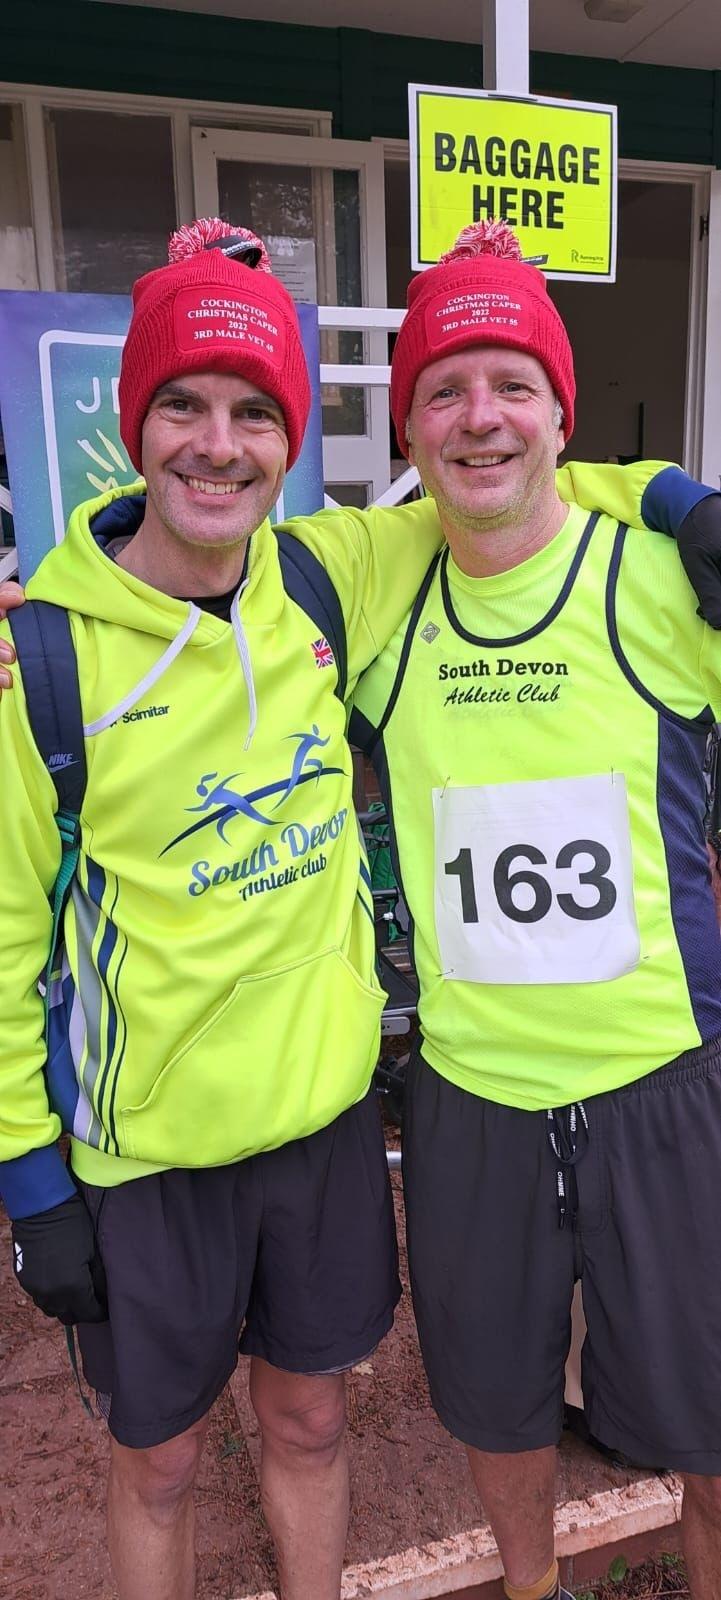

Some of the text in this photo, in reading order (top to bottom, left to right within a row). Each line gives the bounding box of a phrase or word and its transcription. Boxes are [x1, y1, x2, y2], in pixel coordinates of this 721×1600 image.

[434, 132, 600, 185] BAGGAGE
[472, 184, 565, 229] HERE
[201, 299, 268, 320] COCKINGTON
[436, 300, 522, 317] CHRISTMAS CAPER
[447, 293, 509, 306] COCKINGTON
[187, 309, 278, 336] CHRISTMAS CAPER
[471, 308, 490, 316] 2022
[228, 320, 248, 331] 2022
[441, 321, 459, 333] 3RD
[460, 316, 488, 326] MALE
[489, 316, 507, 324] VET
[194, 329, 214, 340] 3RD
[215, 330, 246, 340] MALE
[248, 334, 266, 348] VET
[438, 658, 569, 681] South Devon
[443, 683, 561, 707] Athletic Club
[122, 705, 170, 723] Scimitar
[48, 752, 73, 766] NIKE
[188, 839, 280, 897] South
[239, 852, 328, 901] Athletic club
[444, 839, 617, 924] 163
